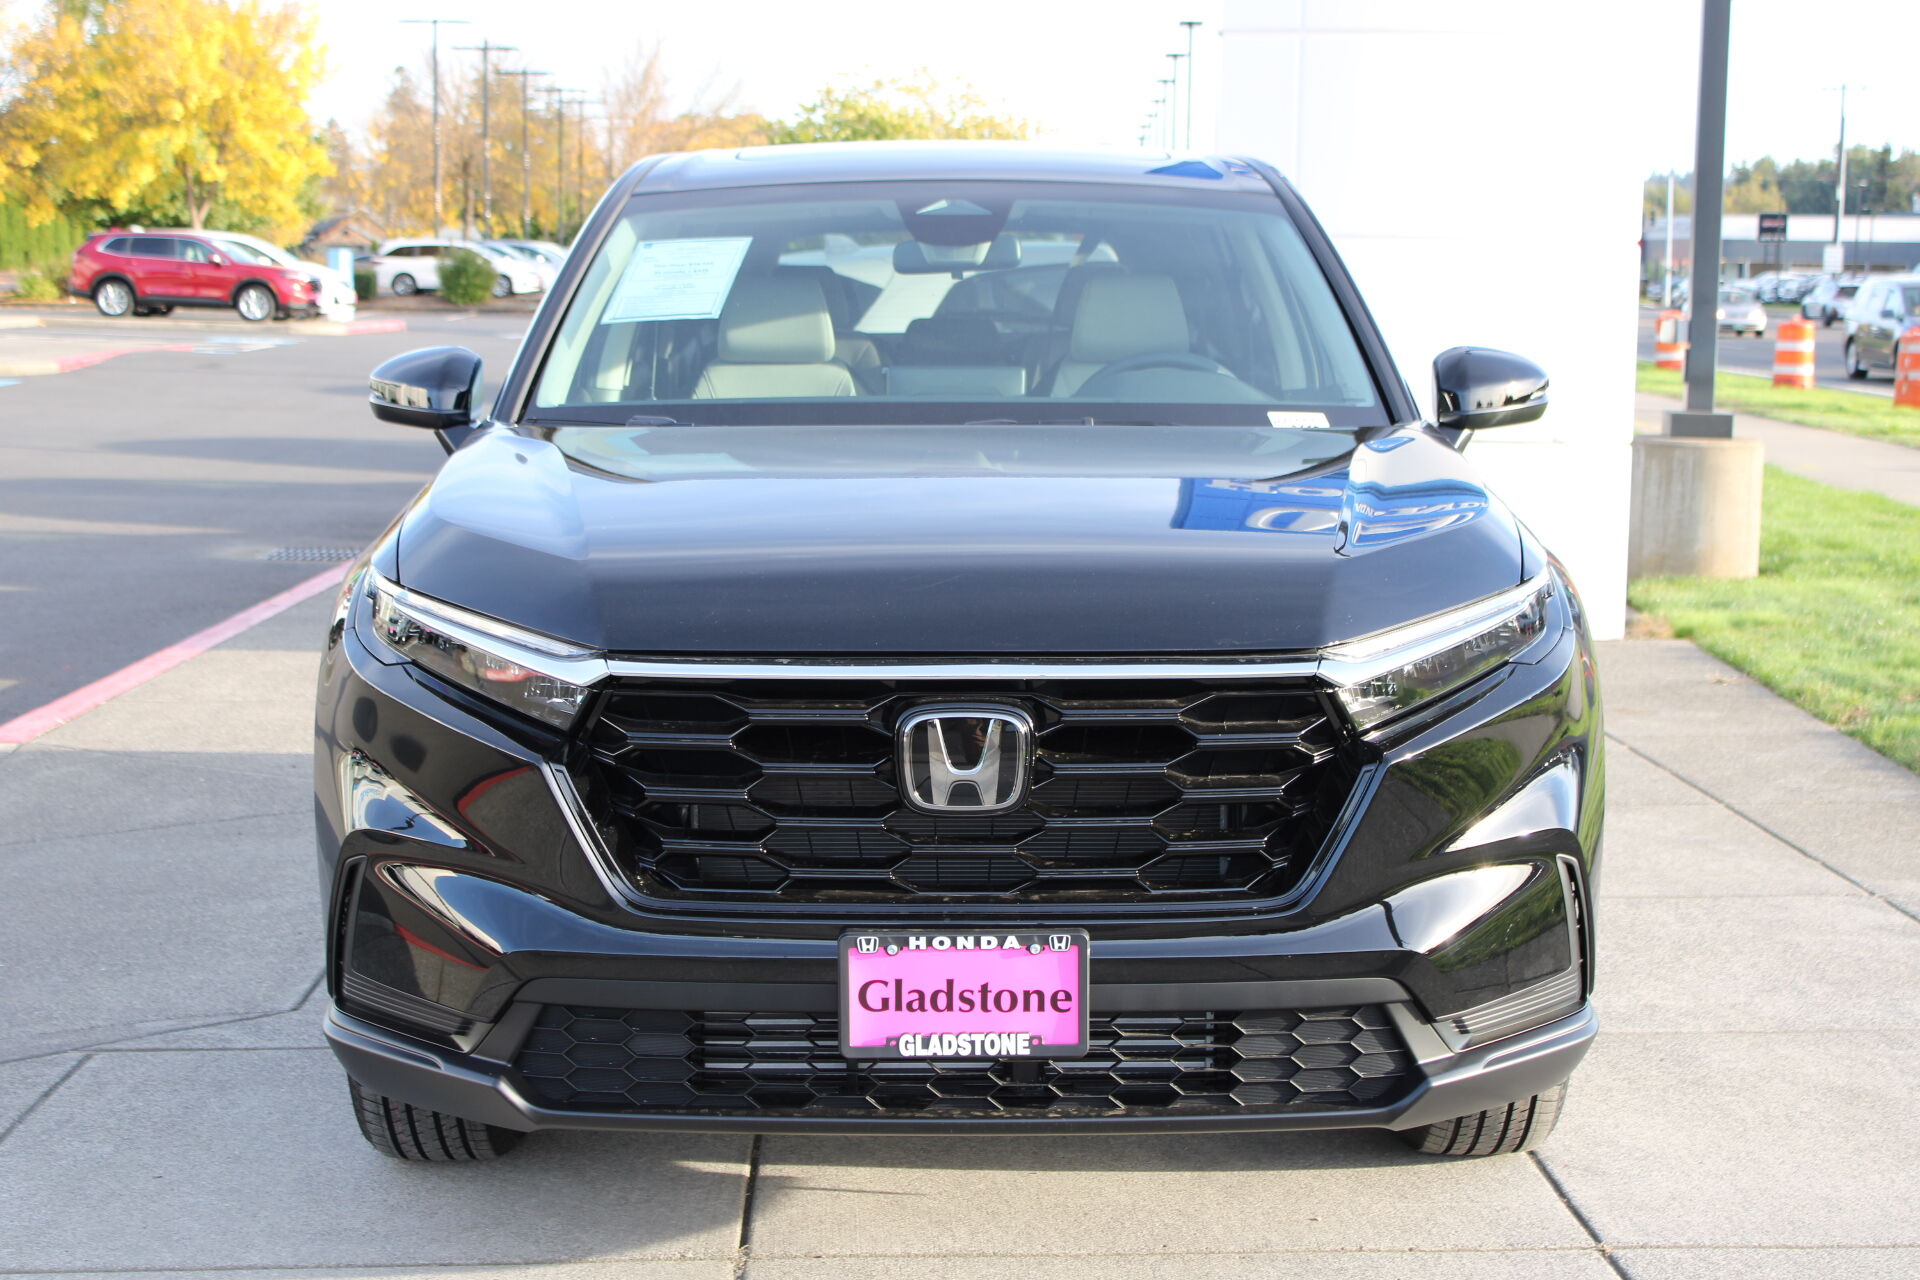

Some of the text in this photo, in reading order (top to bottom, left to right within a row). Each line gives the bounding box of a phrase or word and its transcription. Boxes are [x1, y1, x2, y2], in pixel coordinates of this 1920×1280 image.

[908, 935, 1021, 950] HONDA
[857, 978, 1073, 1013] Gladstone
[898, 1032, 1031, 1057] GLADSTONE
